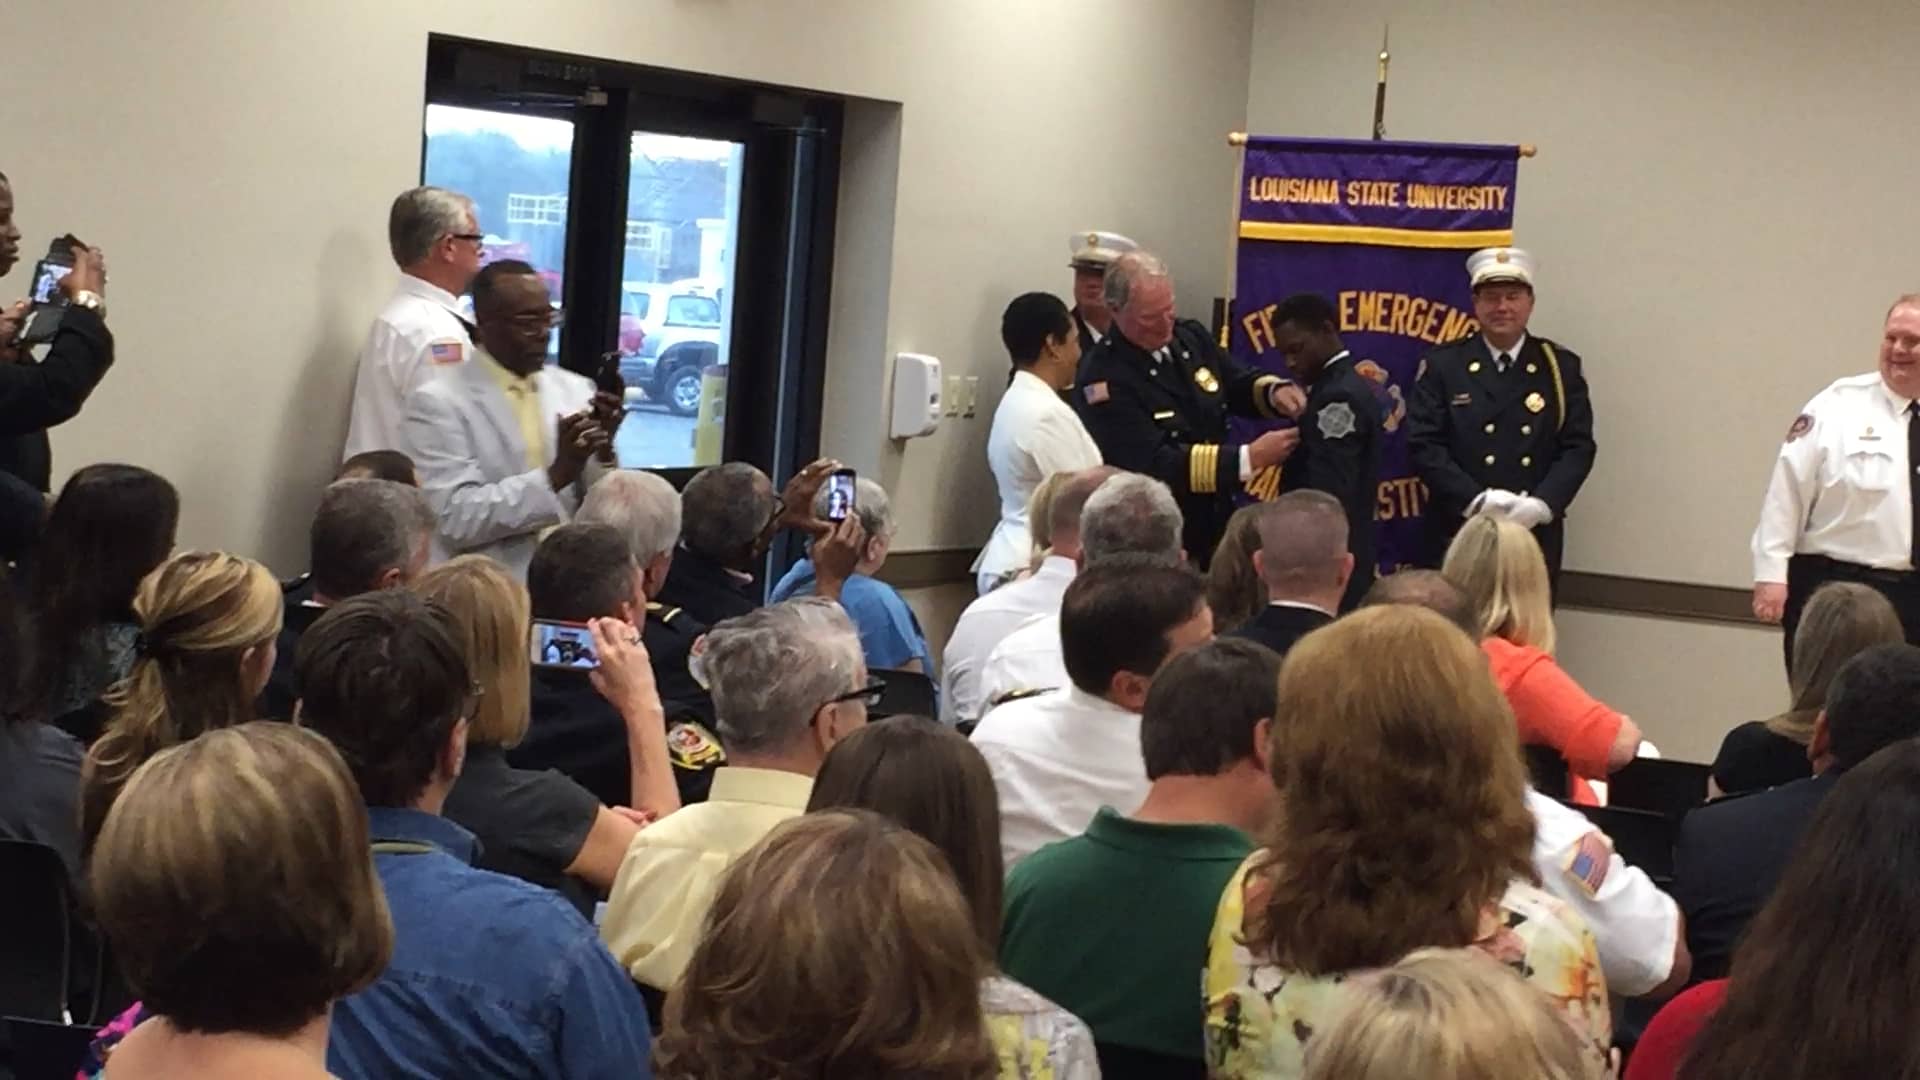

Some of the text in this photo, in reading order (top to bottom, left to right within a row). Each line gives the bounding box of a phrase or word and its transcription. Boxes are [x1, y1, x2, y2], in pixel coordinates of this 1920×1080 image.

[1250, 175, 1507, 211] LOUISIANA STATE UNIVERSITY
[1242, 291, 1481, 355] FI EMERGENC
